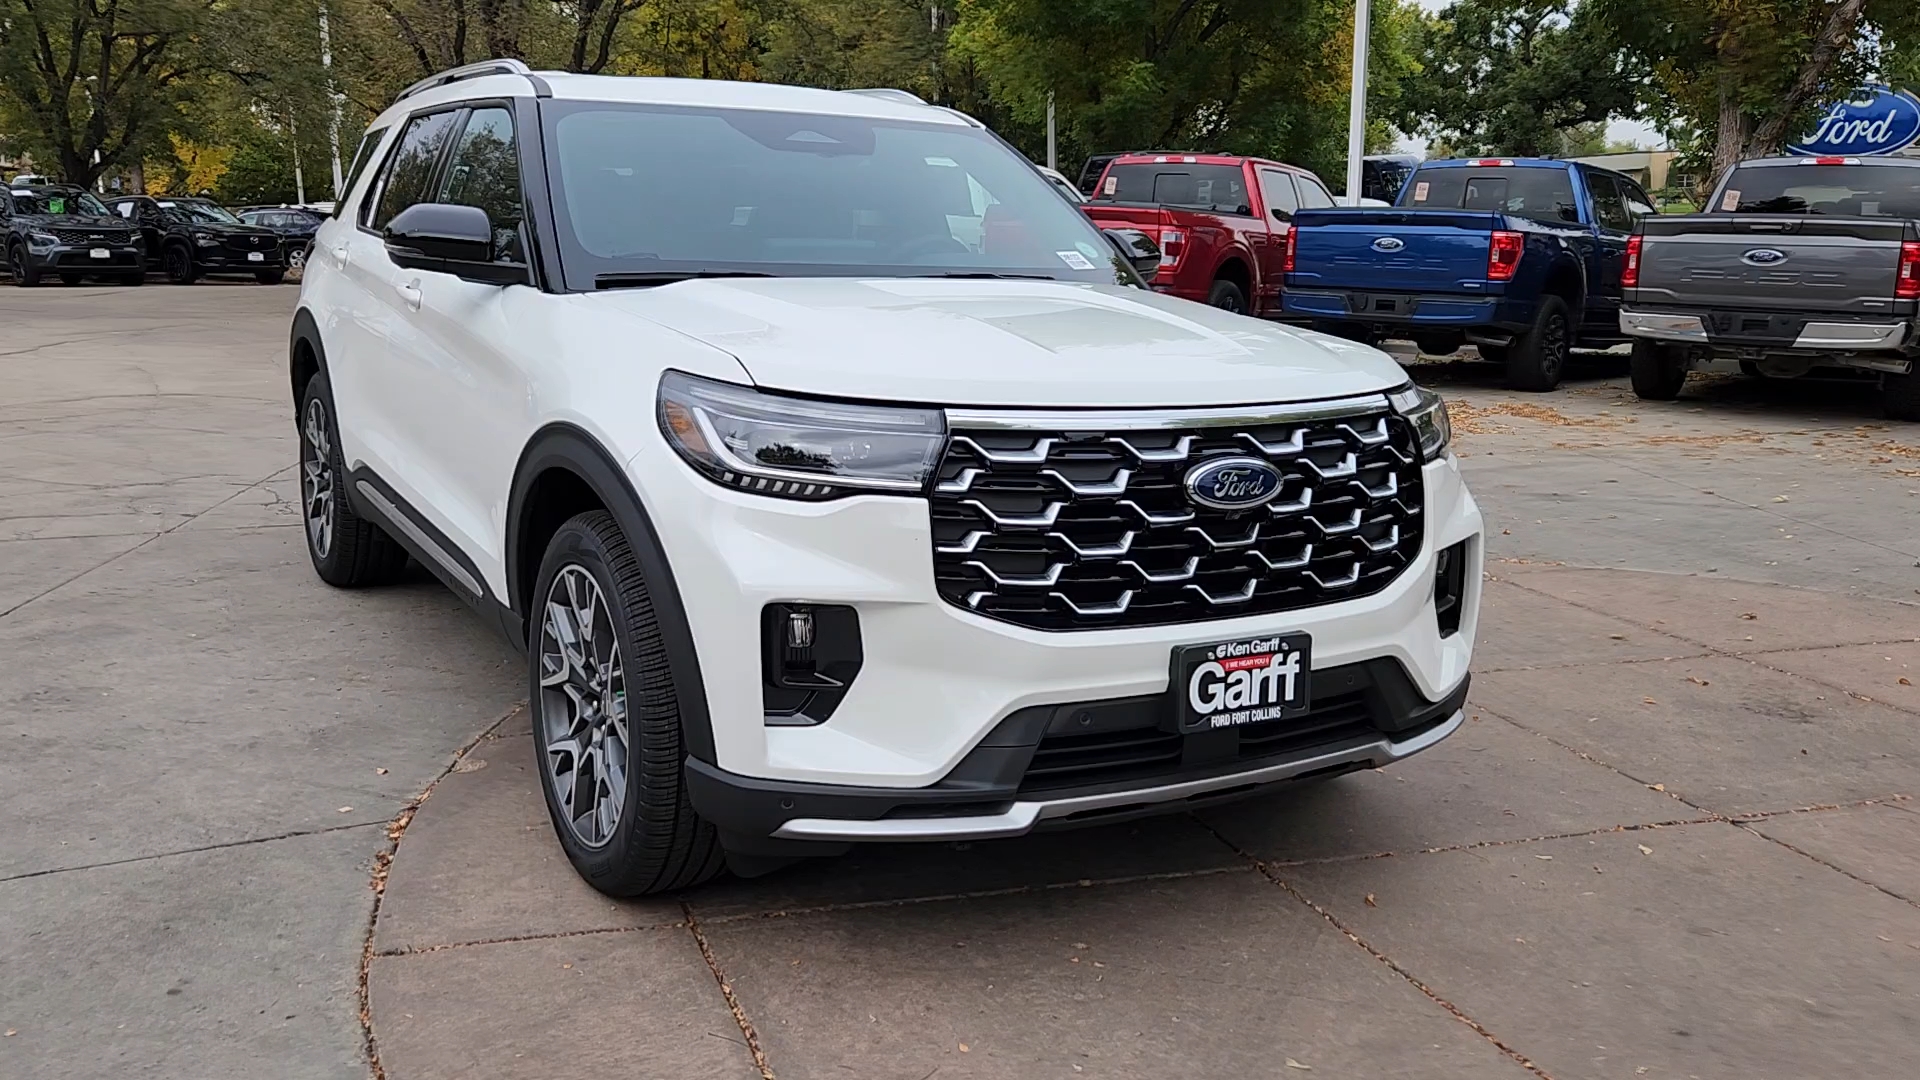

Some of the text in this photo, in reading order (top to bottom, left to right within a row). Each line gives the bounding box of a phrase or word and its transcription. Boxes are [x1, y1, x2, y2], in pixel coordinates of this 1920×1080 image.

[1802, 98, 1897, 145] Ford
[1213, 469, 1265, 498] Ford
[1227, 642, 1250, 657] Ken
[1250, 637, 1280, 654] Garff
[1189, 651, 1300, 714] Garff
[1211, 706, 1281, 728] FORD FORT COLLINS
